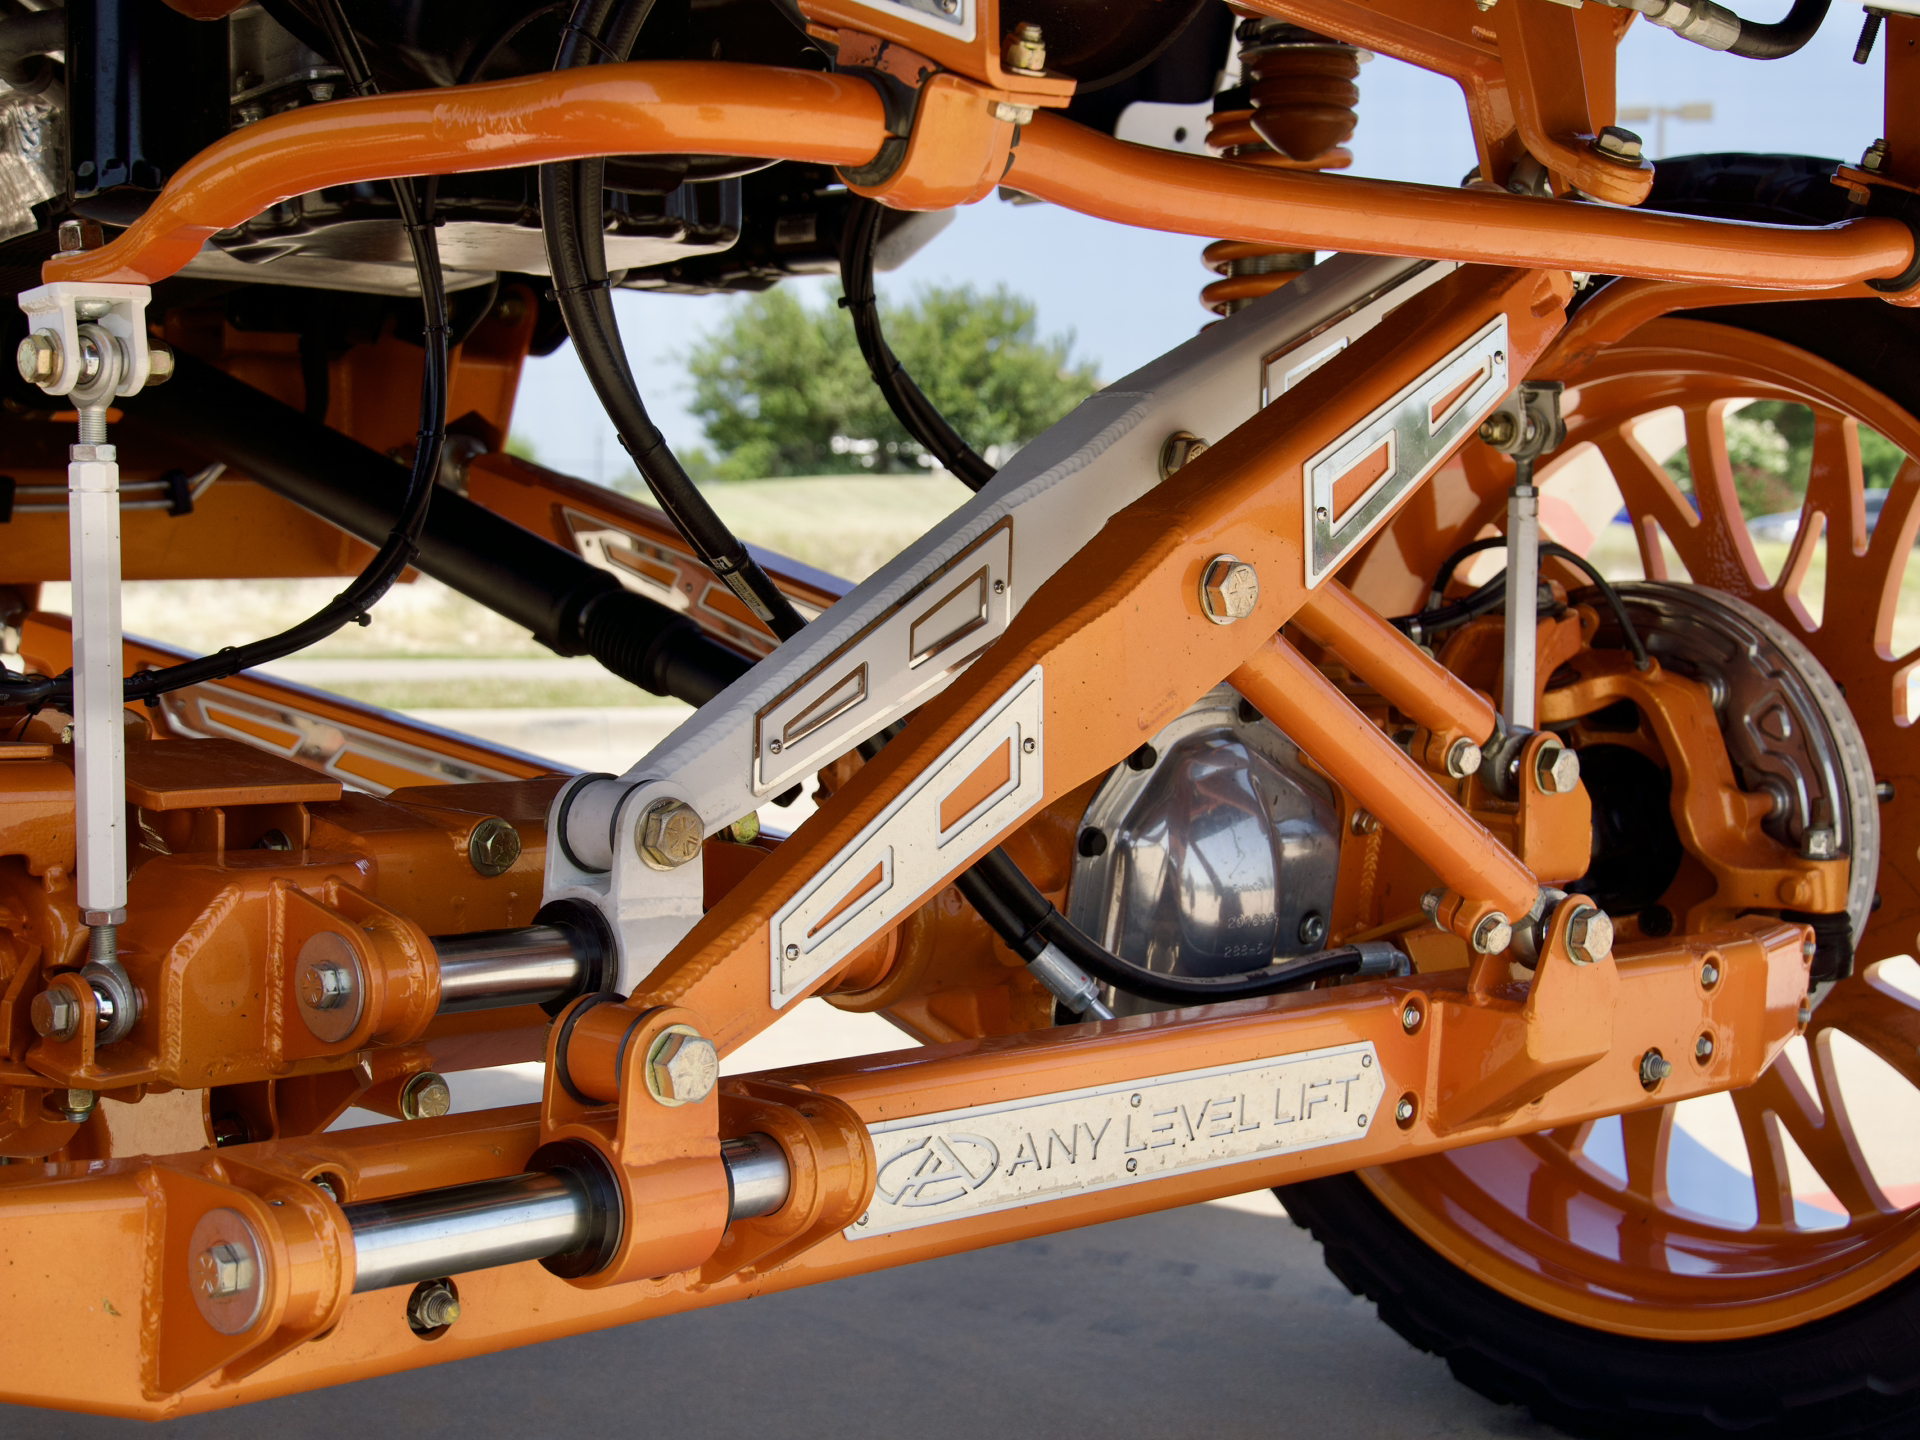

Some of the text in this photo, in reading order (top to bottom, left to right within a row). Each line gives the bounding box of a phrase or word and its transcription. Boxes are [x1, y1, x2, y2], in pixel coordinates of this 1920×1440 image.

[1008, 1074, 1360, 1176] ANY LEVEL LIFT
